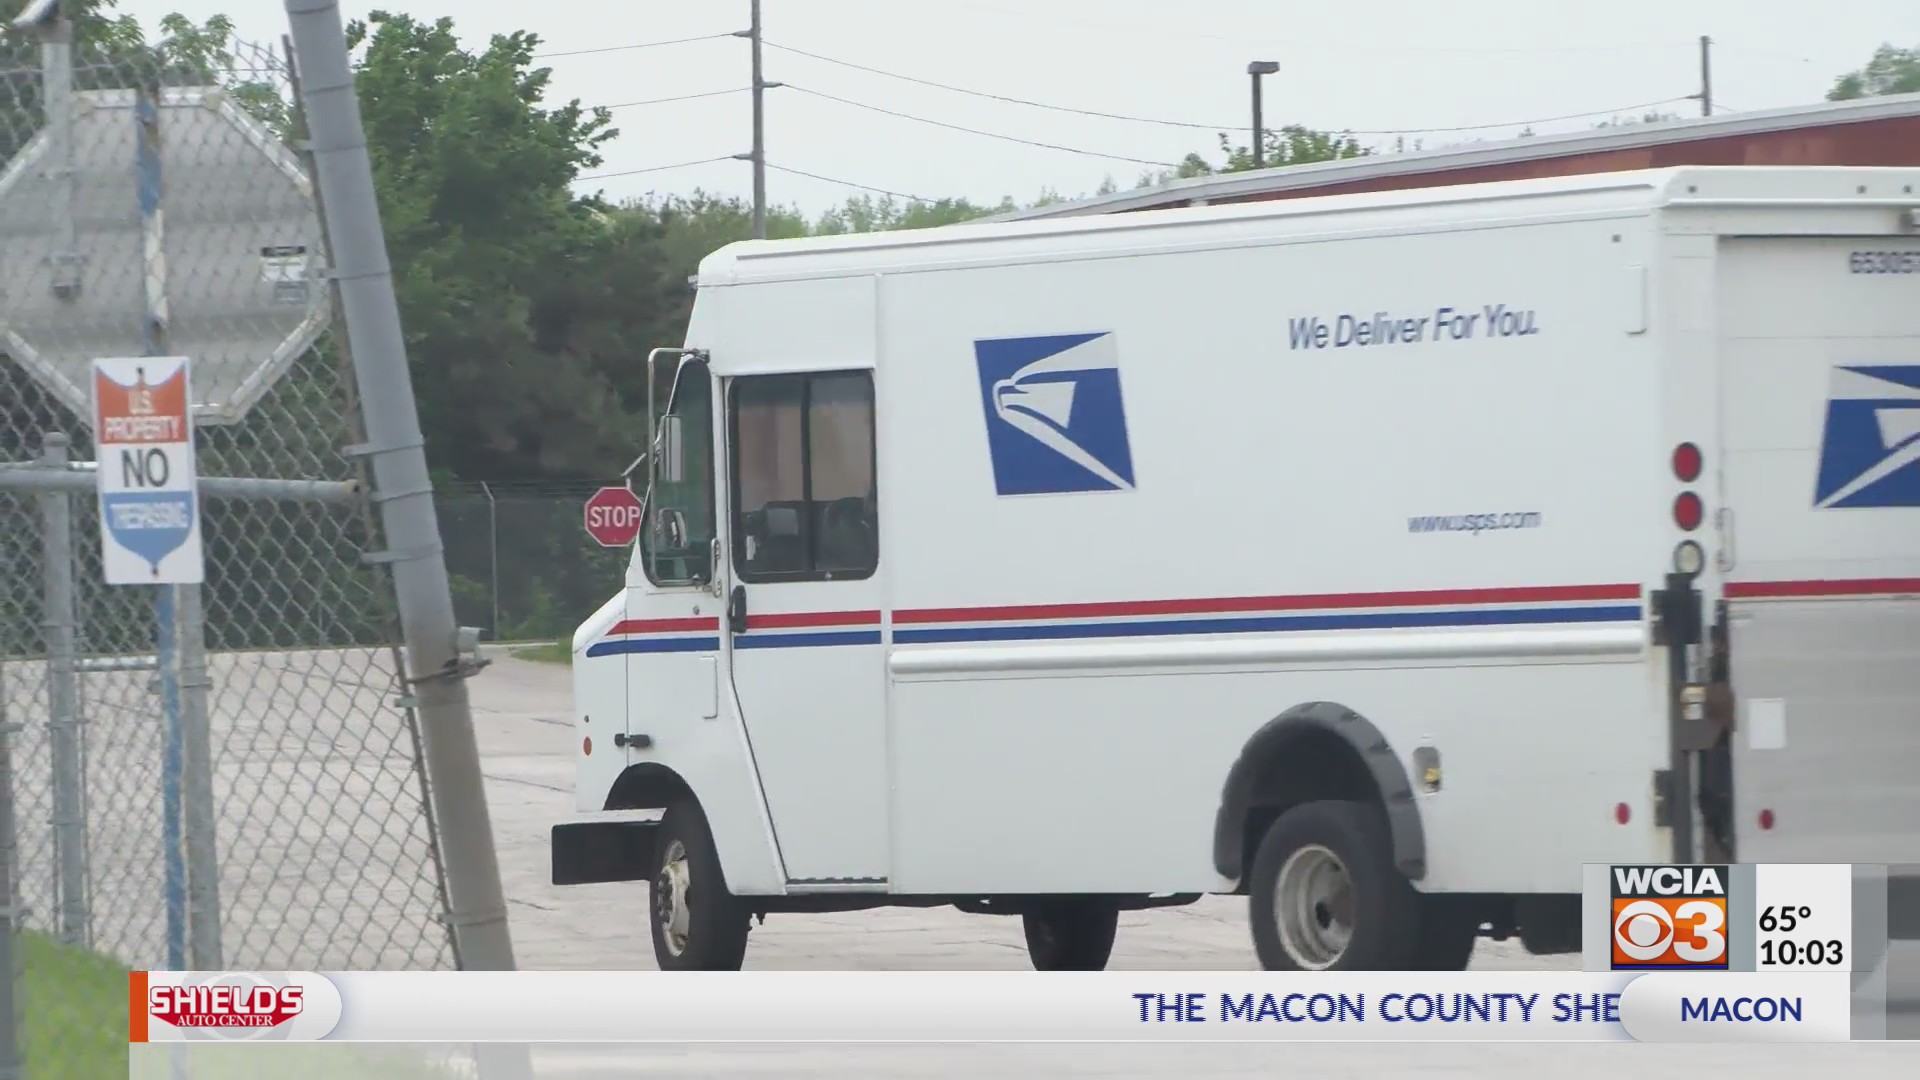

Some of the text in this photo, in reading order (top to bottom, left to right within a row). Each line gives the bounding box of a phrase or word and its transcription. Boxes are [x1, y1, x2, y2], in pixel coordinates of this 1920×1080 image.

[1288, 303, 1540, 350] We Deliver For You.
[103, 415, 181, 441] PROPERTY
[121, 447, 169, 488] NO
[589, 505, 641, 528] STOP
[1407, 511, 1543, 536] www.usps.com
